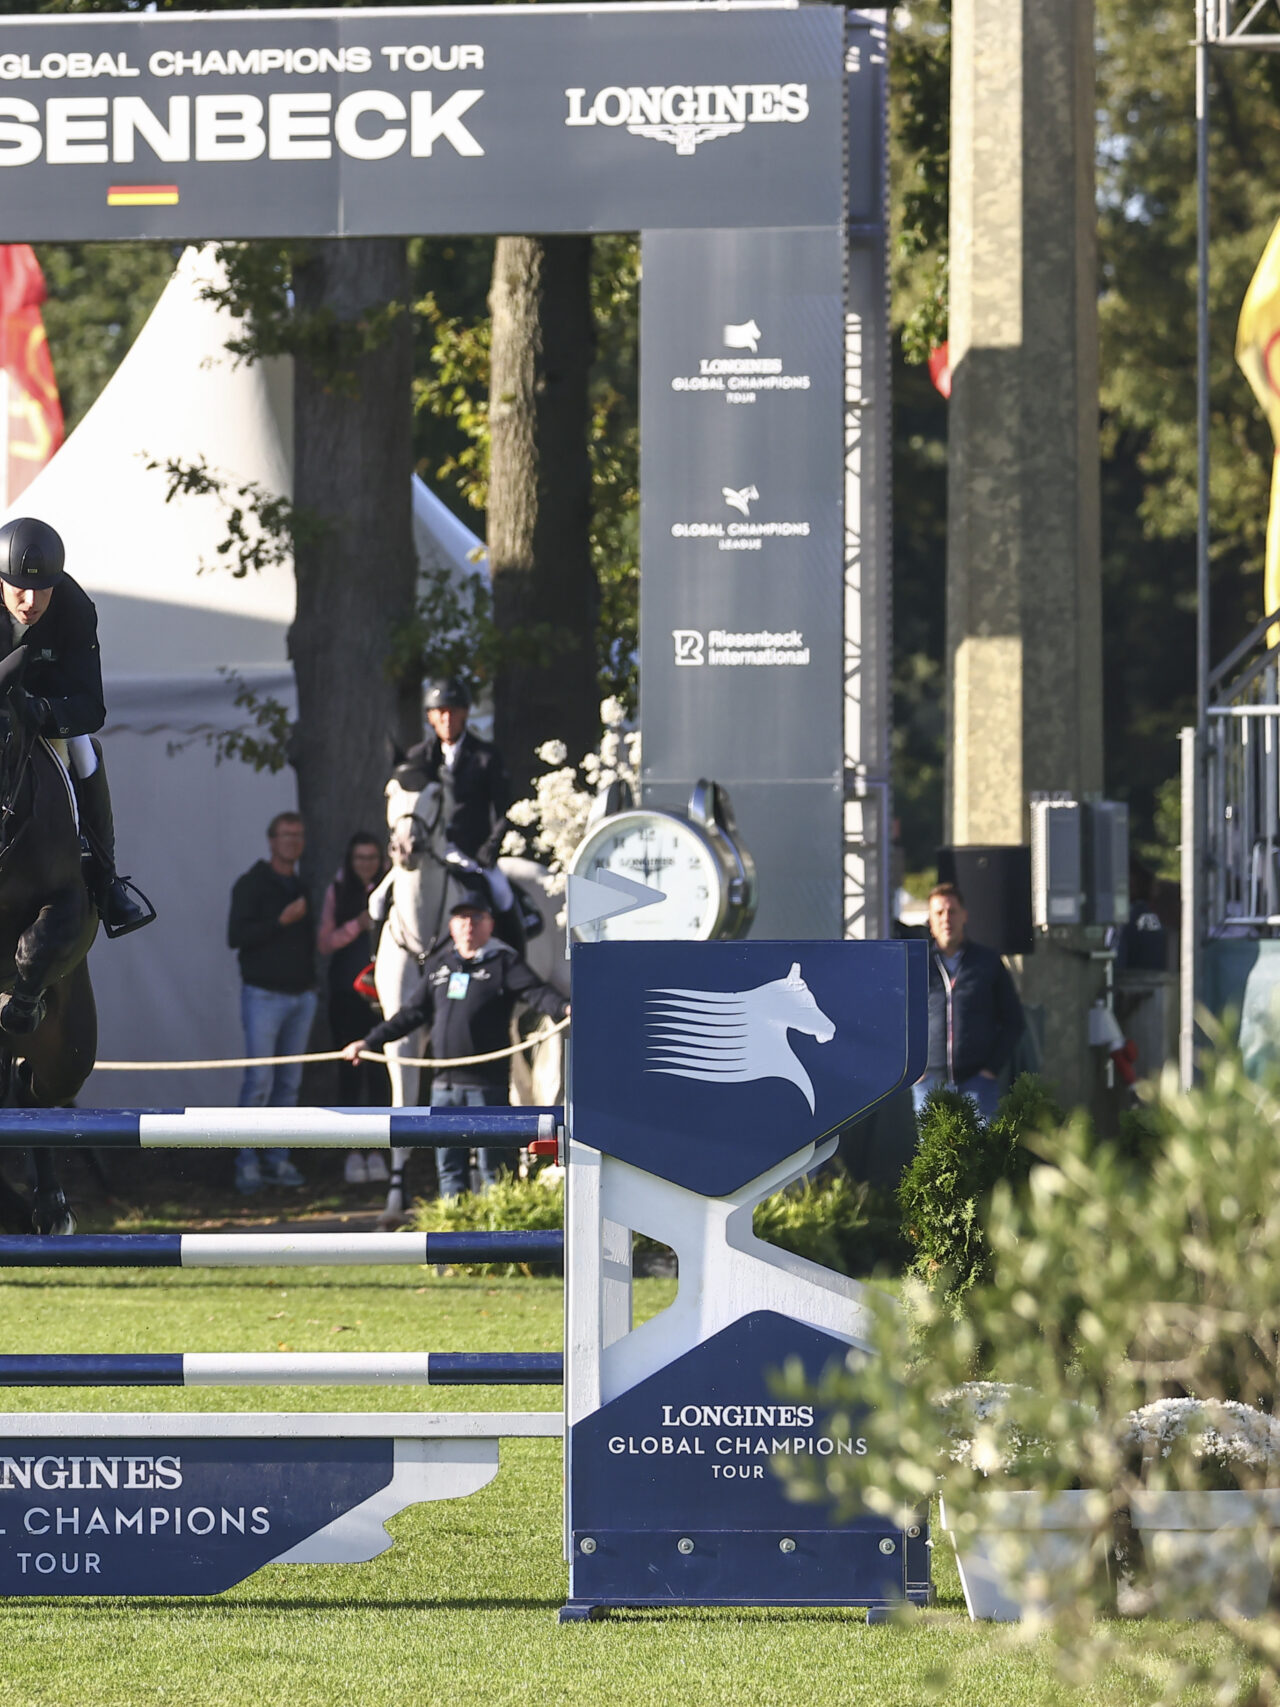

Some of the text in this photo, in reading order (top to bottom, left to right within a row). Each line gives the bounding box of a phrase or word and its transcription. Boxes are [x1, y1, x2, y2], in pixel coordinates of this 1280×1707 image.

[148, 46, 372, 78] CHAMPIONS
[381, 44, 485, 72] TOUR
[565, 83, 810, 127] LONGINES
[699, 358, 782, 375] LONGINES
[671, 376, 810, 391] GLOBAL CHAMPIONS
[726, 392, 756, 404] TOUR
[671, 522, 810, 537] GLOBAL CHAMPIONS
[718, 538, 762, 551] LEAGUE
[708, 629, 804, 648] Riesenbeck
[708, 647, 810, 666] International
[662, 1405, 814, 1427] LONGINES
[608, 1436, 868, 1456] GLOBAL CHAMPIONS
[711, 1464, 764, 1480] TOUR
[24, 1506, 272, 1536] CHAMPIONS
[17, 1552, 102, 1575] TOUR
